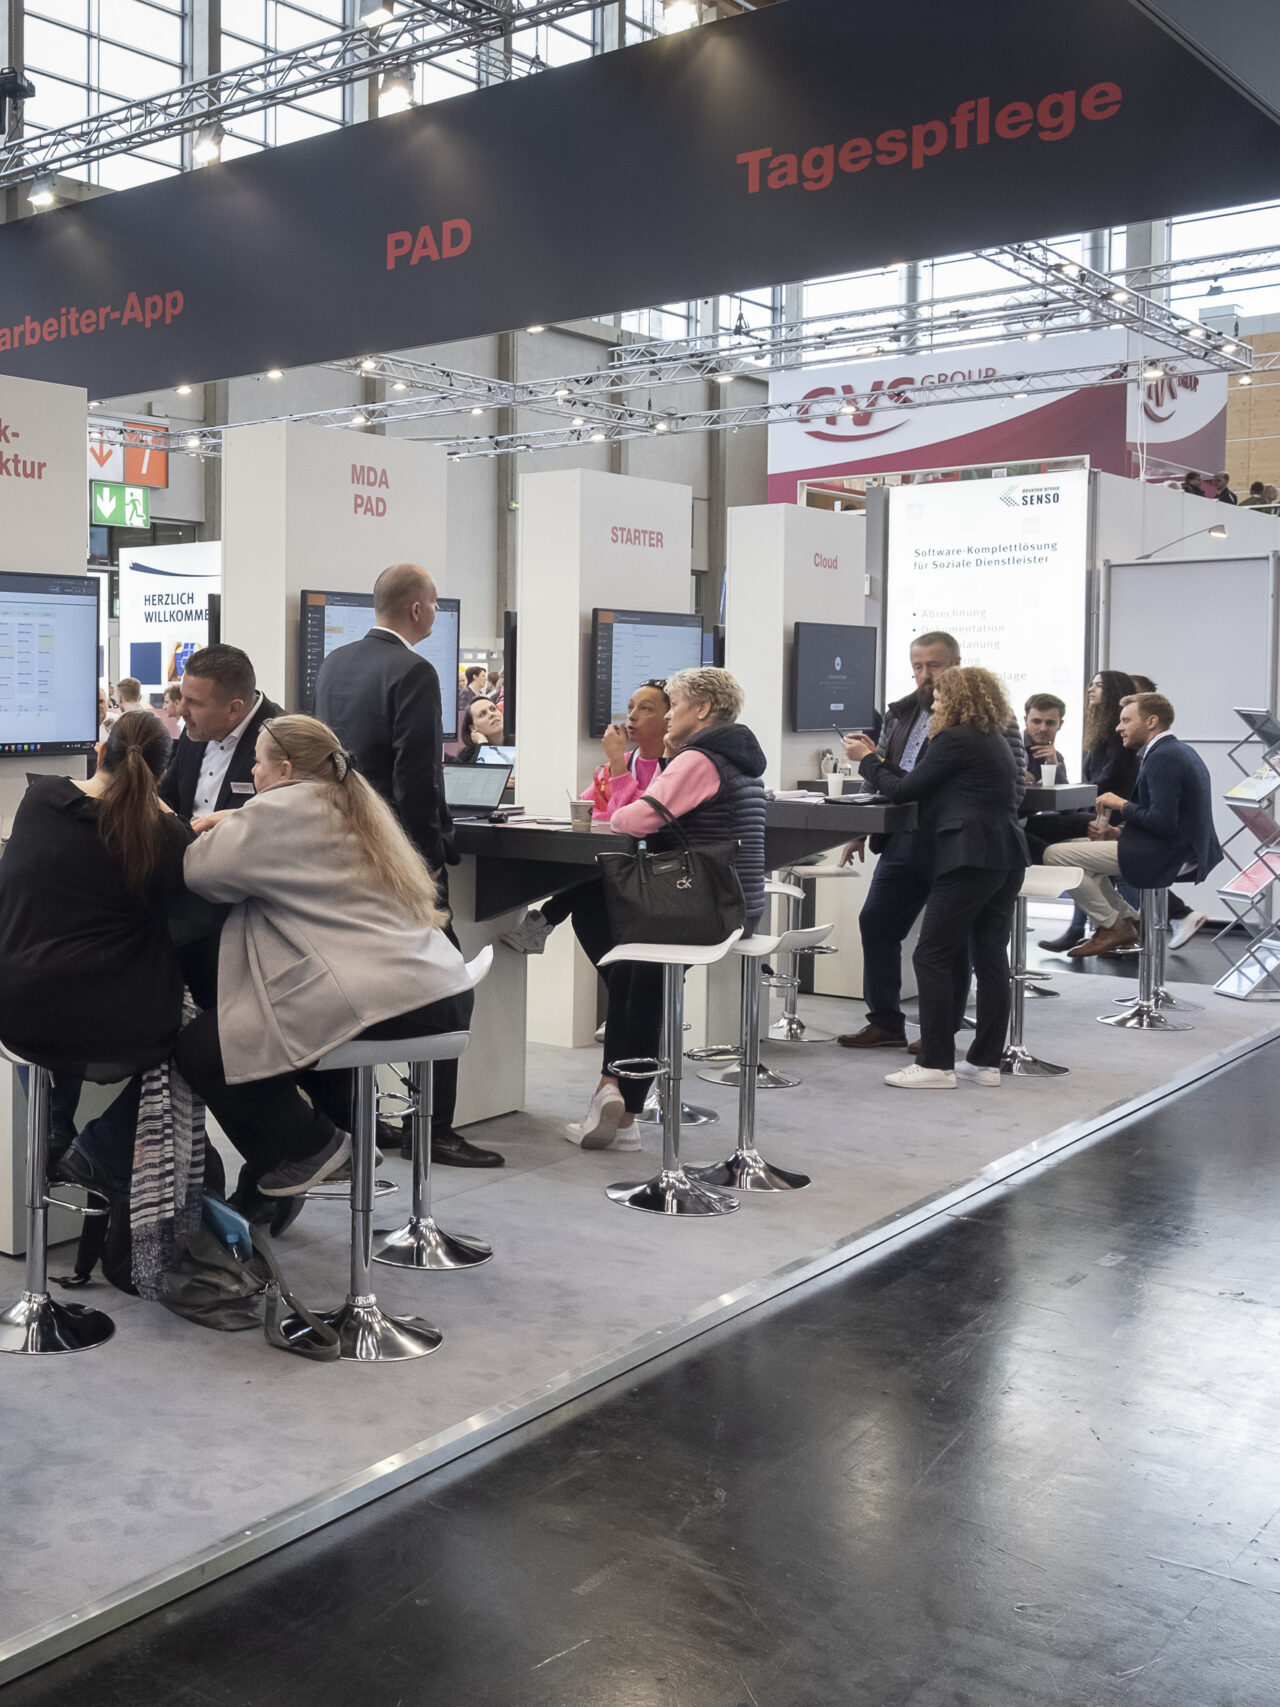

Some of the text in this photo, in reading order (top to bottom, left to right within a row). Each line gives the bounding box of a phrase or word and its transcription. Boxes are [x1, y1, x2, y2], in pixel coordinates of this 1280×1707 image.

[736, 81, 1123, 194] Tagespflege
[386, 218, 473, 271] PAD
[350, 463, 390, 490] MDA
[353, 493, 387, 518] PAD
[1021, 492, 1060, 506] SENSO
[610, 526, 664, 549] STARTER
[914, 540, 1058, 558] Software-Komplettlösung
[813, 552, 838, 570] Cloud
[913, 554, 1049, 570] für Soziale Dienstleister
[144, 592, 194, 606] HERZLICH
[144, 608, 209, 623] WILLKOMME
[922, 607, 987, 618] Abrechnung
